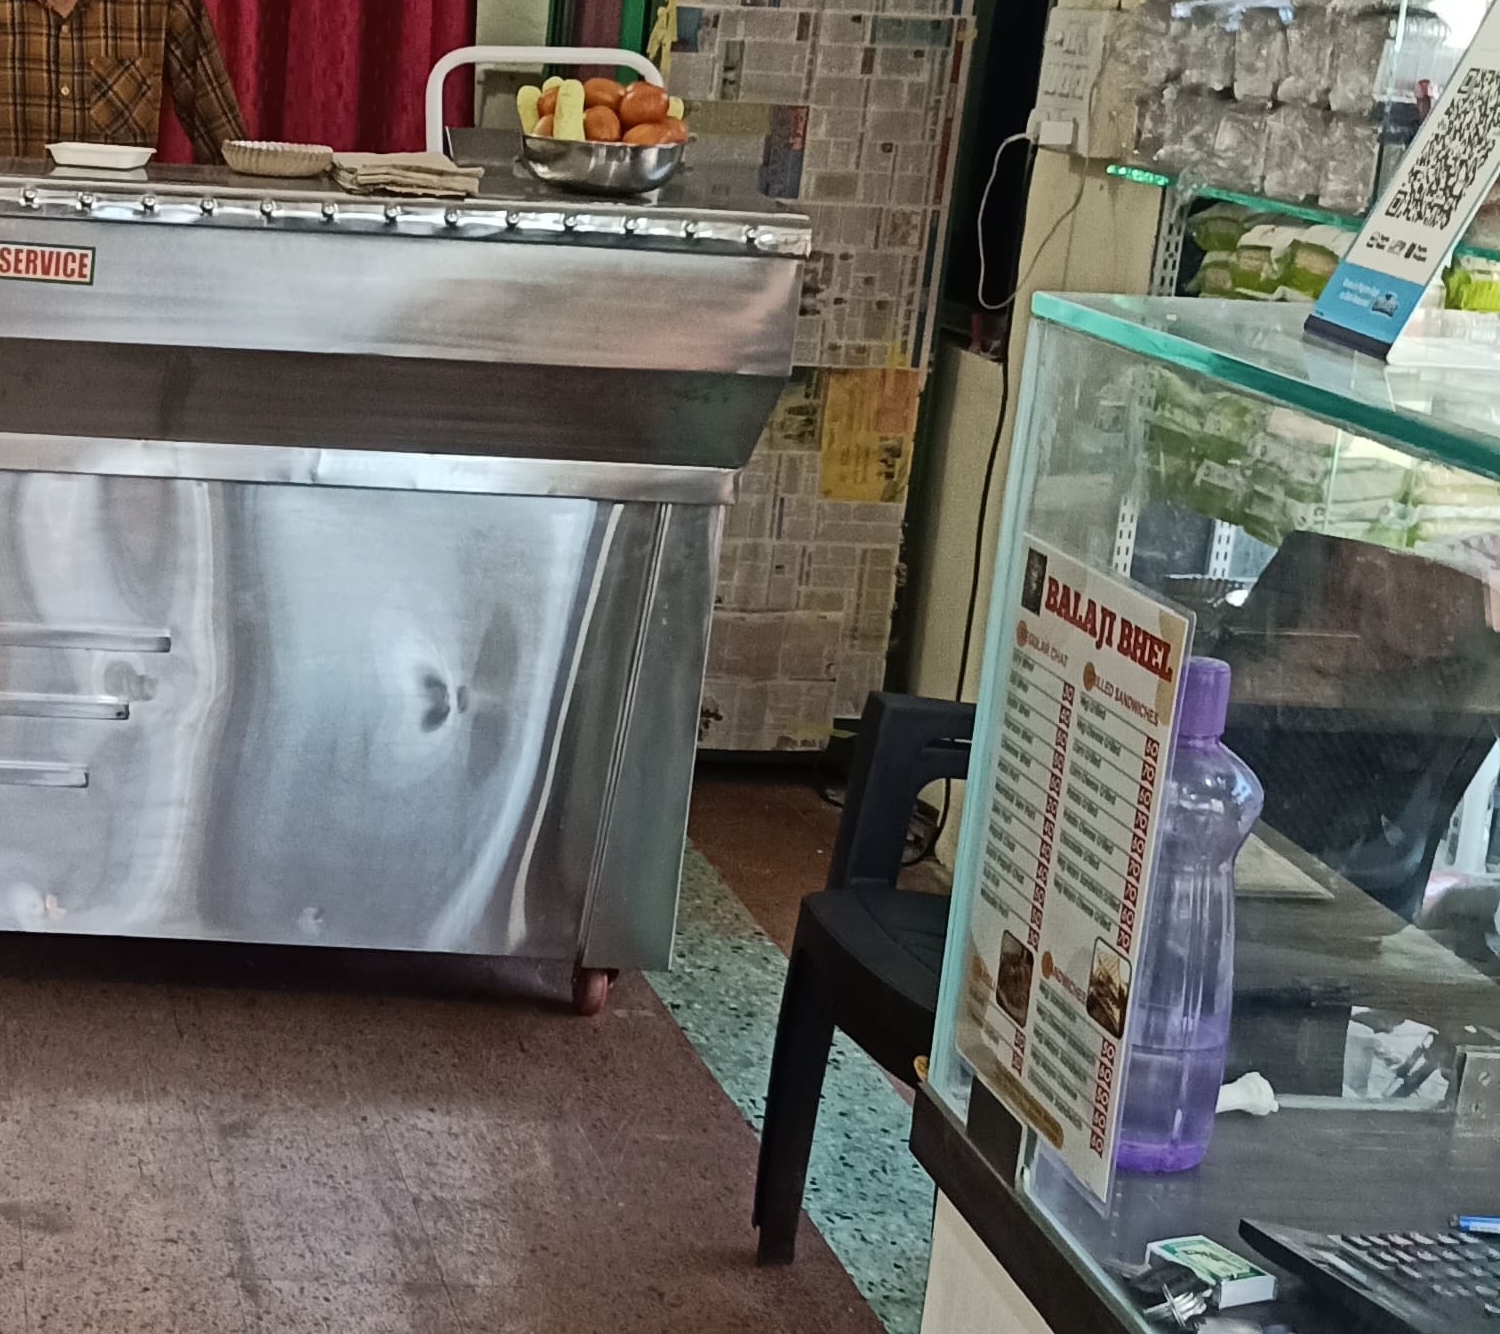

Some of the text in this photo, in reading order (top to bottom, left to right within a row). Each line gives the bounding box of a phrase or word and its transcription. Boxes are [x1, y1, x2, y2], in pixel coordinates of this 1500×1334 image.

[1045, 575, 1173, 683] BALAJI BHEL
[1142, 762, 1155, 783] 70
[1135, 812, 1147, 831] 70
[1128, 860, 1140, 881] 70
[1124, 881, 1137, 903] 70
[1117, 929, 1130, 950] 70
